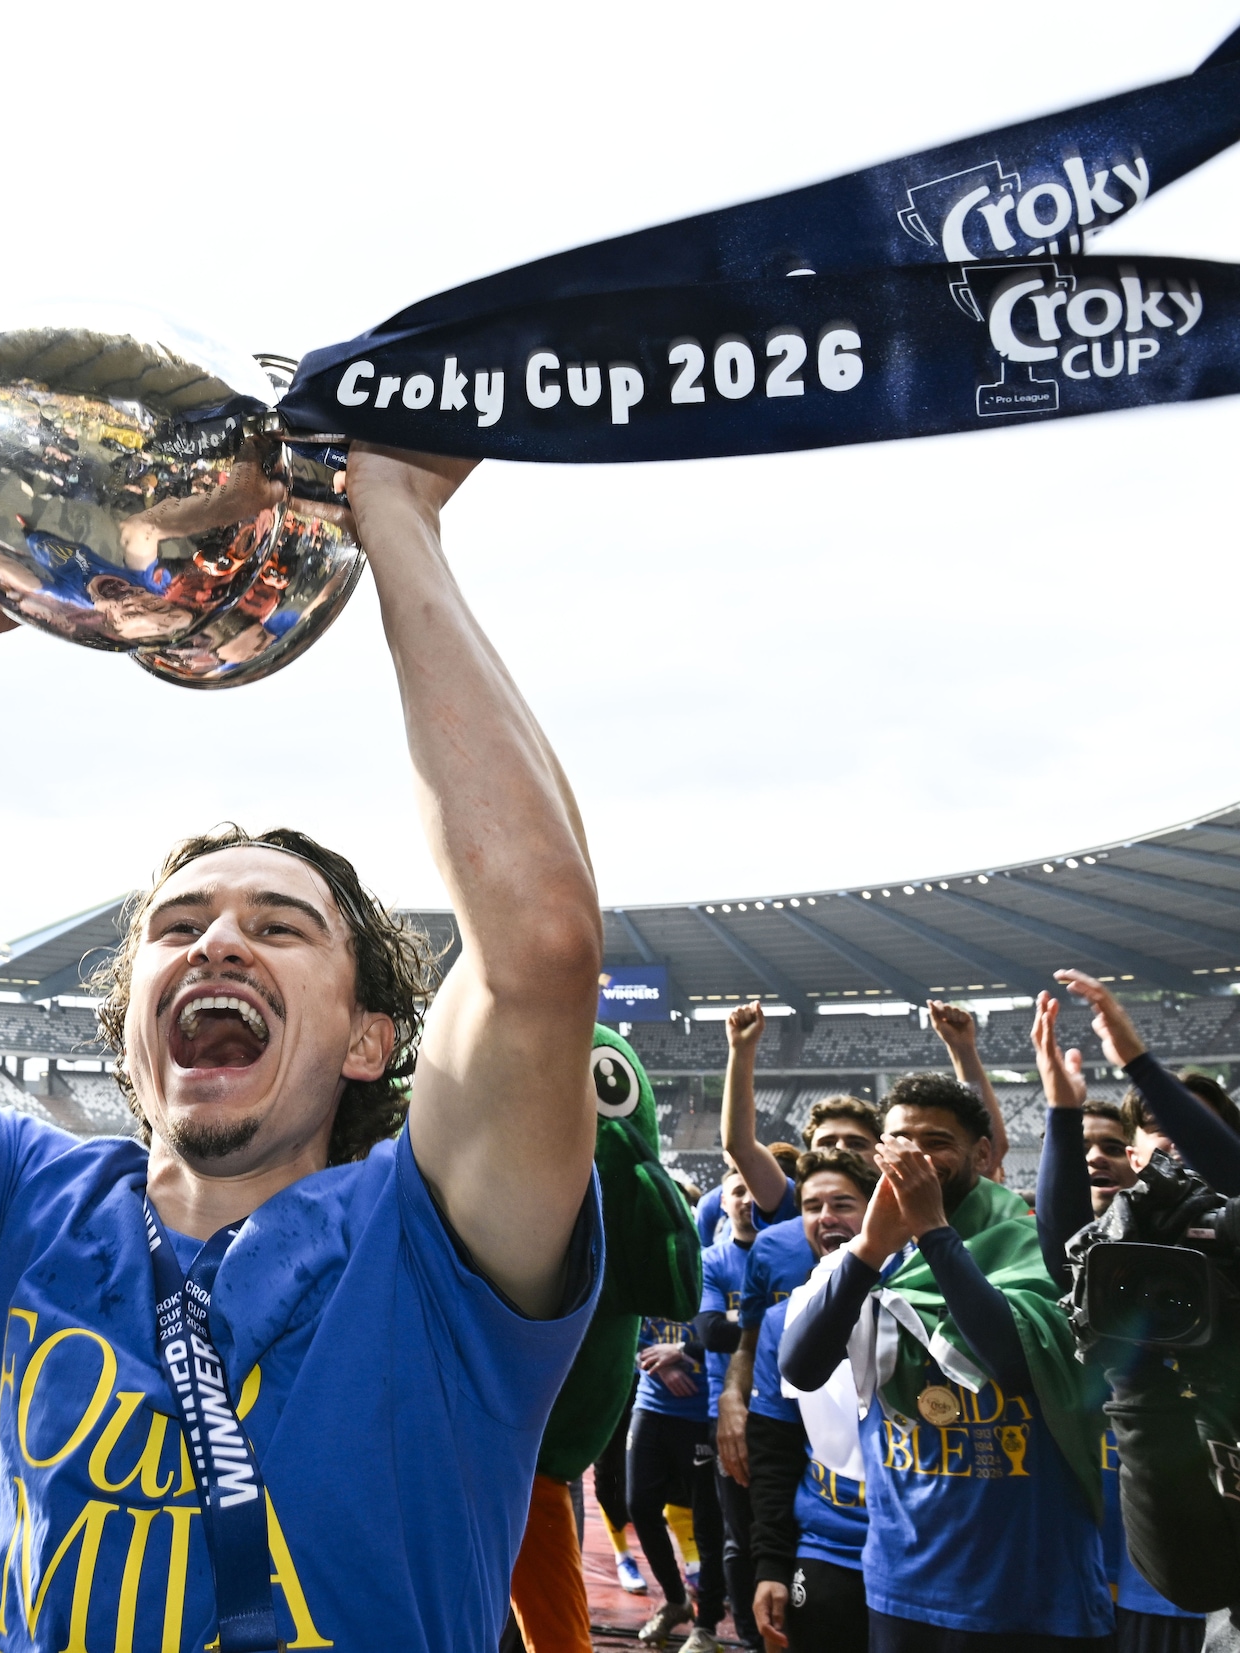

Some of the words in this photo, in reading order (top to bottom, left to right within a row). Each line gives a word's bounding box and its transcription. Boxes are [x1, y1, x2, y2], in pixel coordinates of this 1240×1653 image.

[989, 277, 1203, 362] Croky
[337, 354, 504, 428] Croky
[525, 352, 645, 425] Cup
[668, 328, 864, 404] 2026
[1062, 338, 1160, 379] CUP
[996, 394, 1013, 404] Pro
[1015, 392, 1050, 404] League
[602, 988, 660, 1000] WINNERS
[187, 1300, 207, 1320] CUP
[191, 1333, 259, 1508] WINNER
[883, 1419, 972, 1477] BLE
